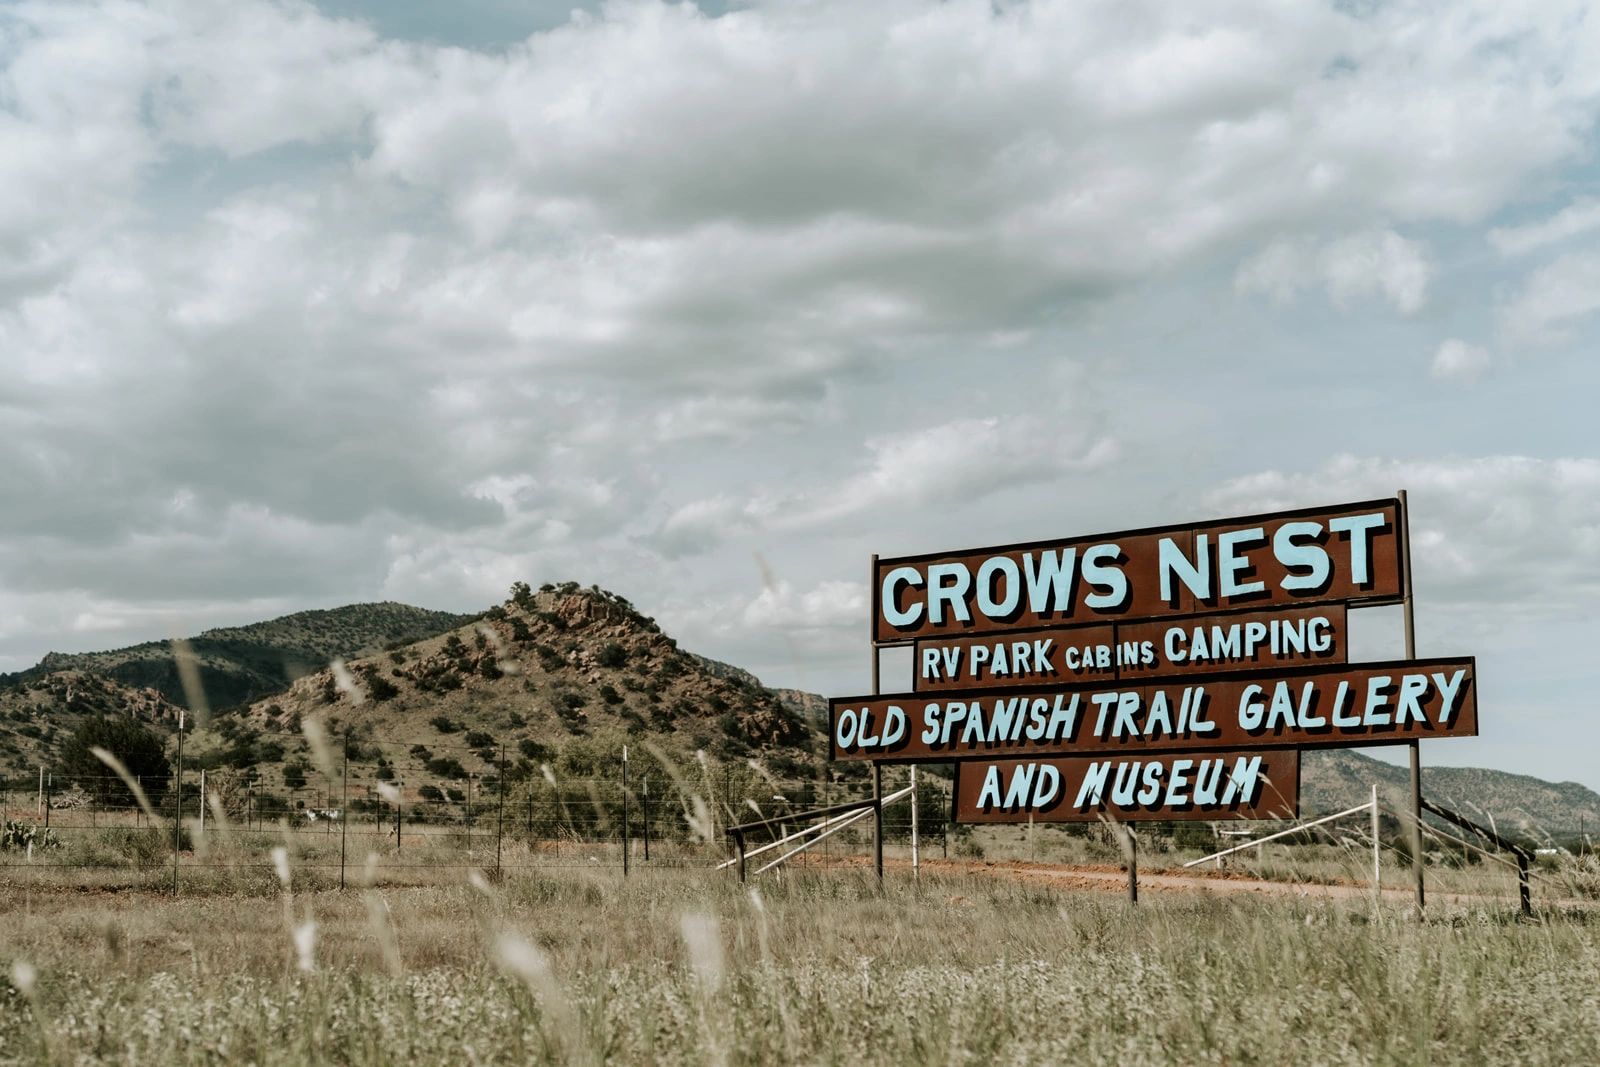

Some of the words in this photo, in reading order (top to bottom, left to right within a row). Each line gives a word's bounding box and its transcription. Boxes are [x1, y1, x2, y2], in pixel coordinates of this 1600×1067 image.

[881, 543, 1128, 627] CROWS
[1158, 512, 1386, 602] NEST
[922, 647, 961, 679] RV
[970, 638, 1054, 676] PARK
[1164, 616, 1332, 662] CAMPING
[836, 708, 907, 748] OLD
[921, 694, 1080, 745] SPANISH
[1091, 687, 1216, 737] TRAIL
[1238, 669, 1467, 731] GALLERY
[976, 764, 1060, 808] AND
[1074, 756, 1262, 808] MUSEUM
